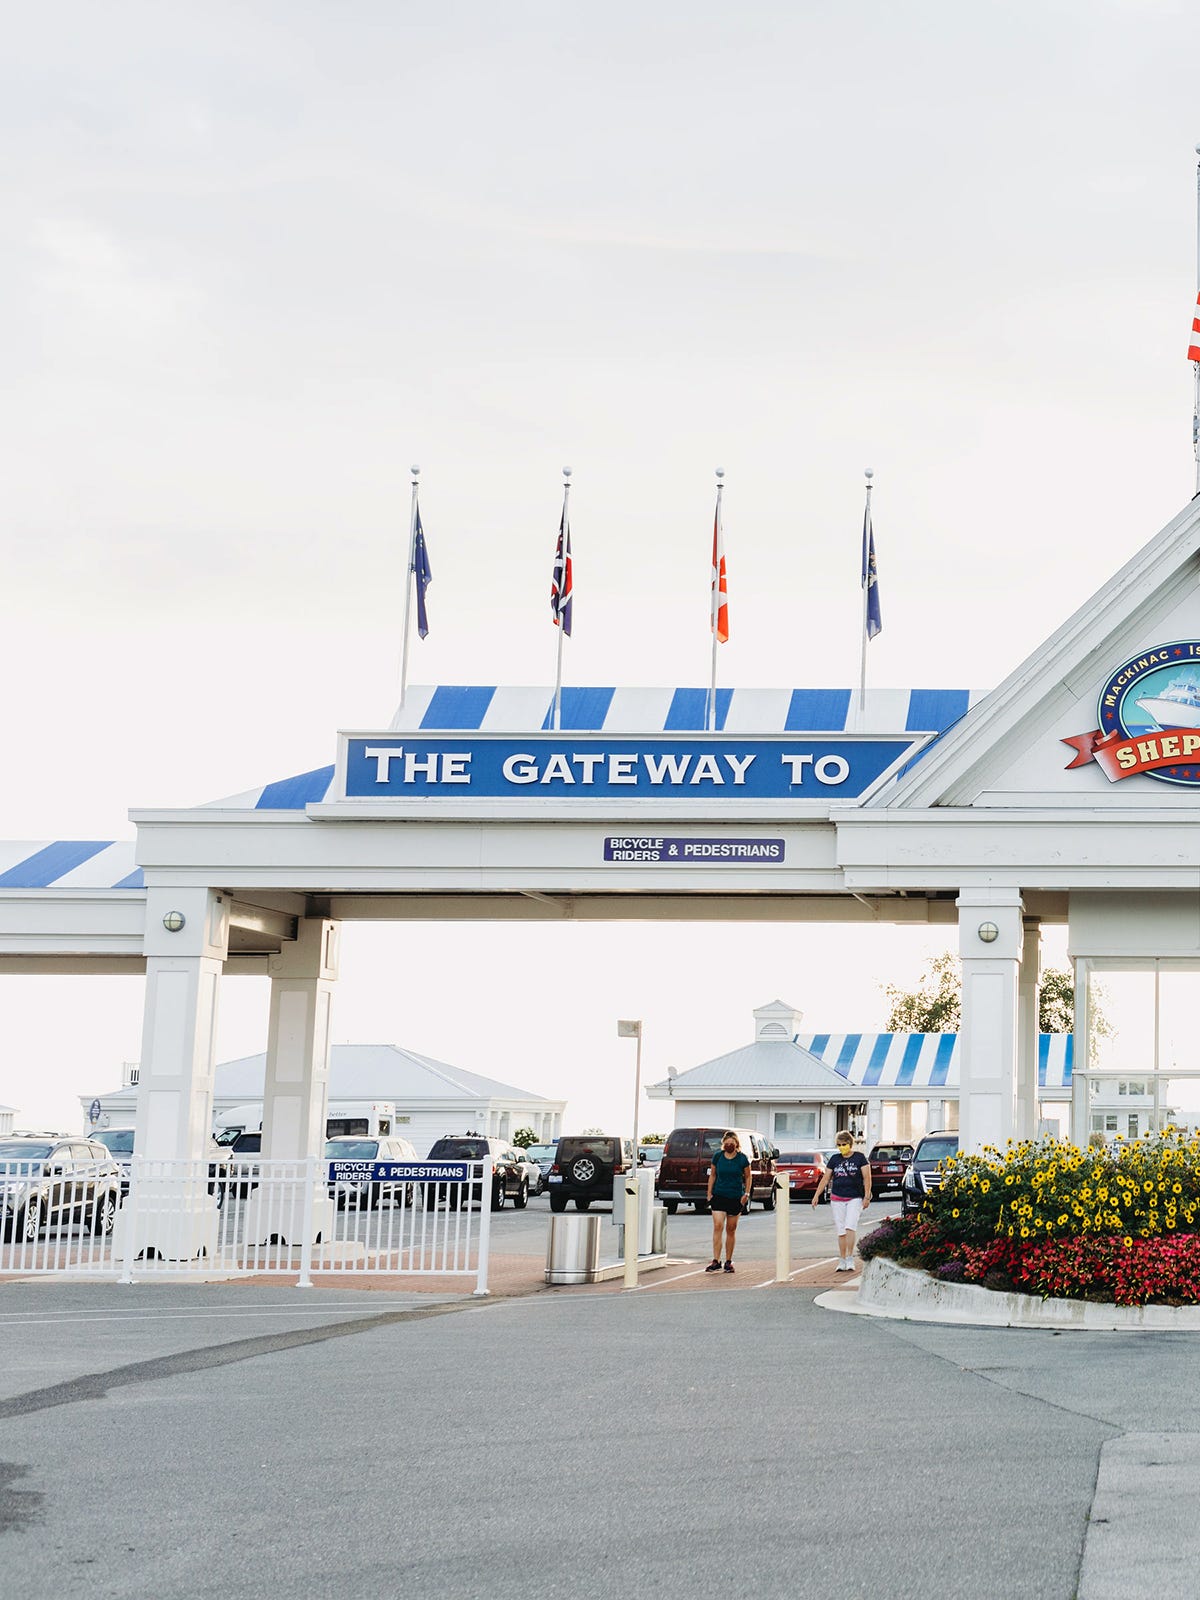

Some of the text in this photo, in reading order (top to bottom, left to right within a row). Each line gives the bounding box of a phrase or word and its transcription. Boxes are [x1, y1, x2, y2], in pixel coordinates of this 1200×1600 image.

[1104, 650, 1169, 707] MACKINAC
[364, 746, 850, 785] THE GATEWAY TO
[610, 838, 664, 849] BICYCLE
[613, 850, 660, 861] RIDERS
[668, 844, 780, 857] & PEDESTRIANS
[333, 1163, 375, 1172] BICYCLE
[378, 1167, 464, 1177] & PEDESTRIANS
[336, 1172, 372, 1180] RIDERS
